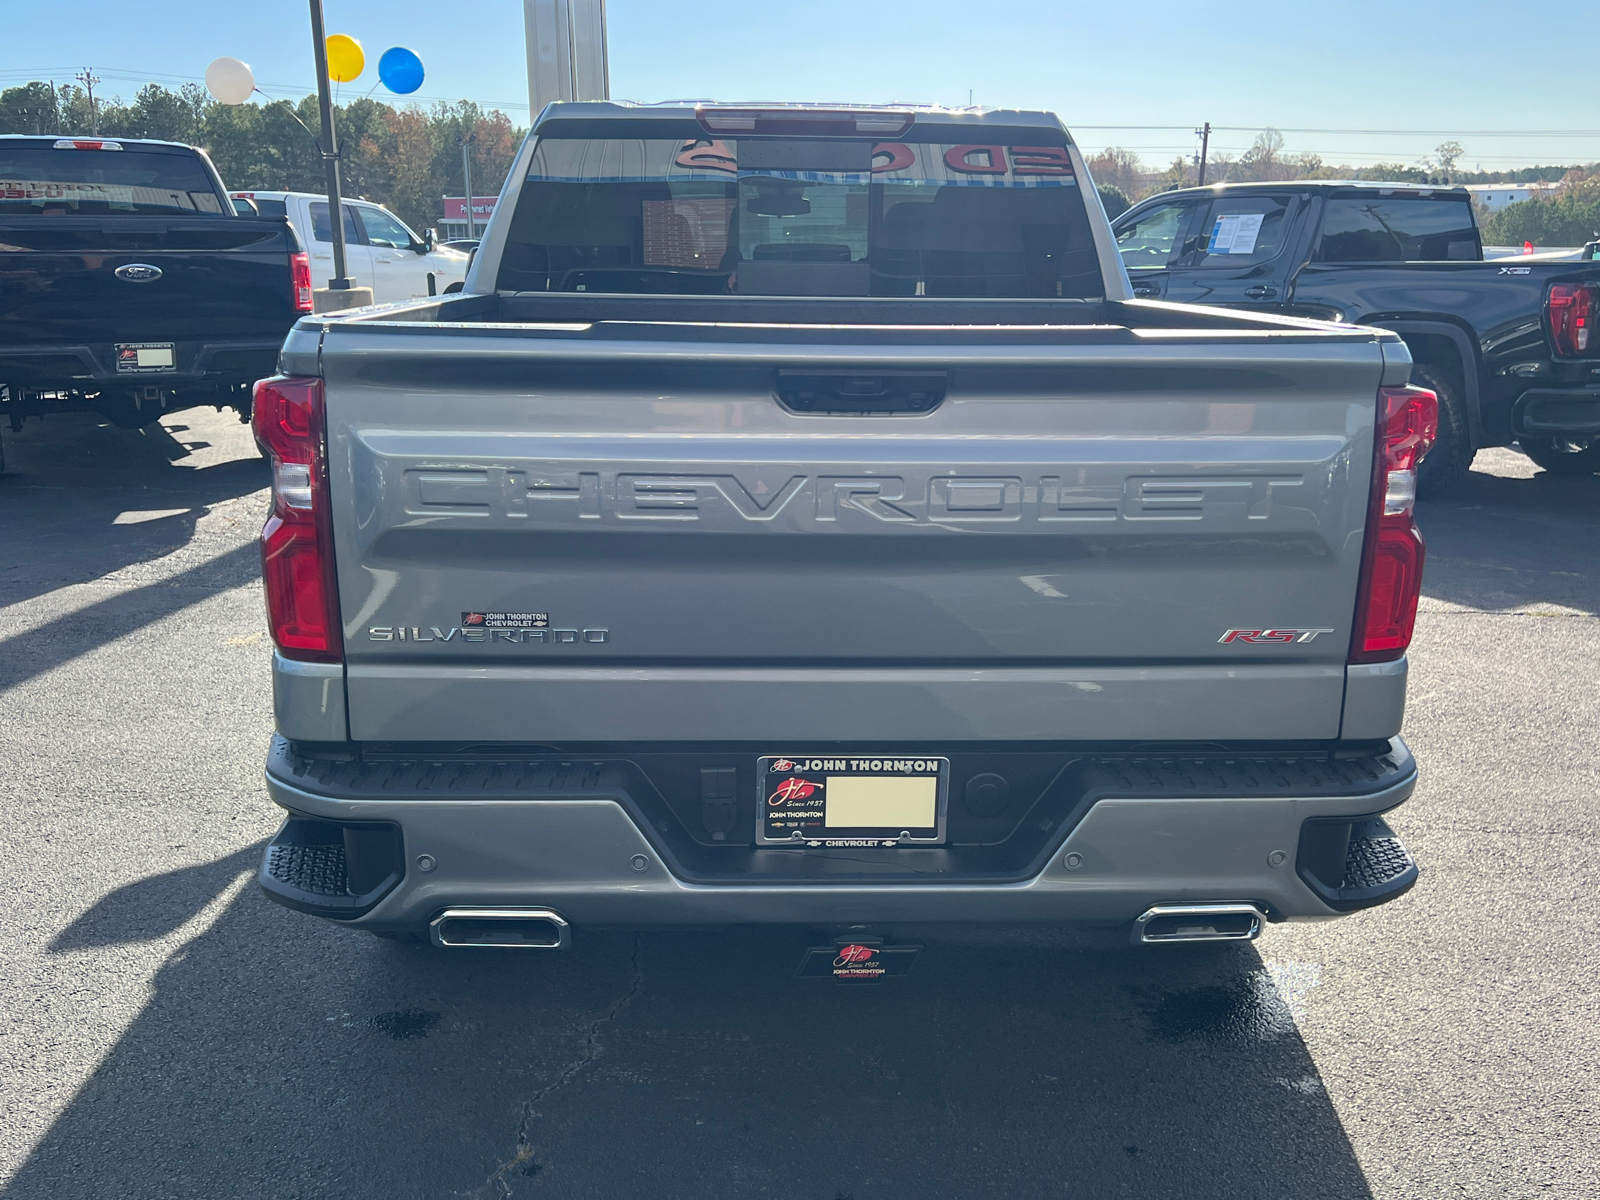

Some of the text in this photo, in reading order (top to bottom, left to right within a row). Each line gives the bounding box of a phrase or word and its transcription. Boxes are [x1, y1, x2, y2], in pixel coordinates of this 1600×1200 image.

[126, 267, 152, 278] Ford
[403, 468, 1304, 523] CHEVROLET
[368, 627, 609, 643] SILVERADO
[1217, 629, 1335, 643] RST
[803, 760, 846, 771] JOHN
[850, 760, 938, 772] THORNTON
